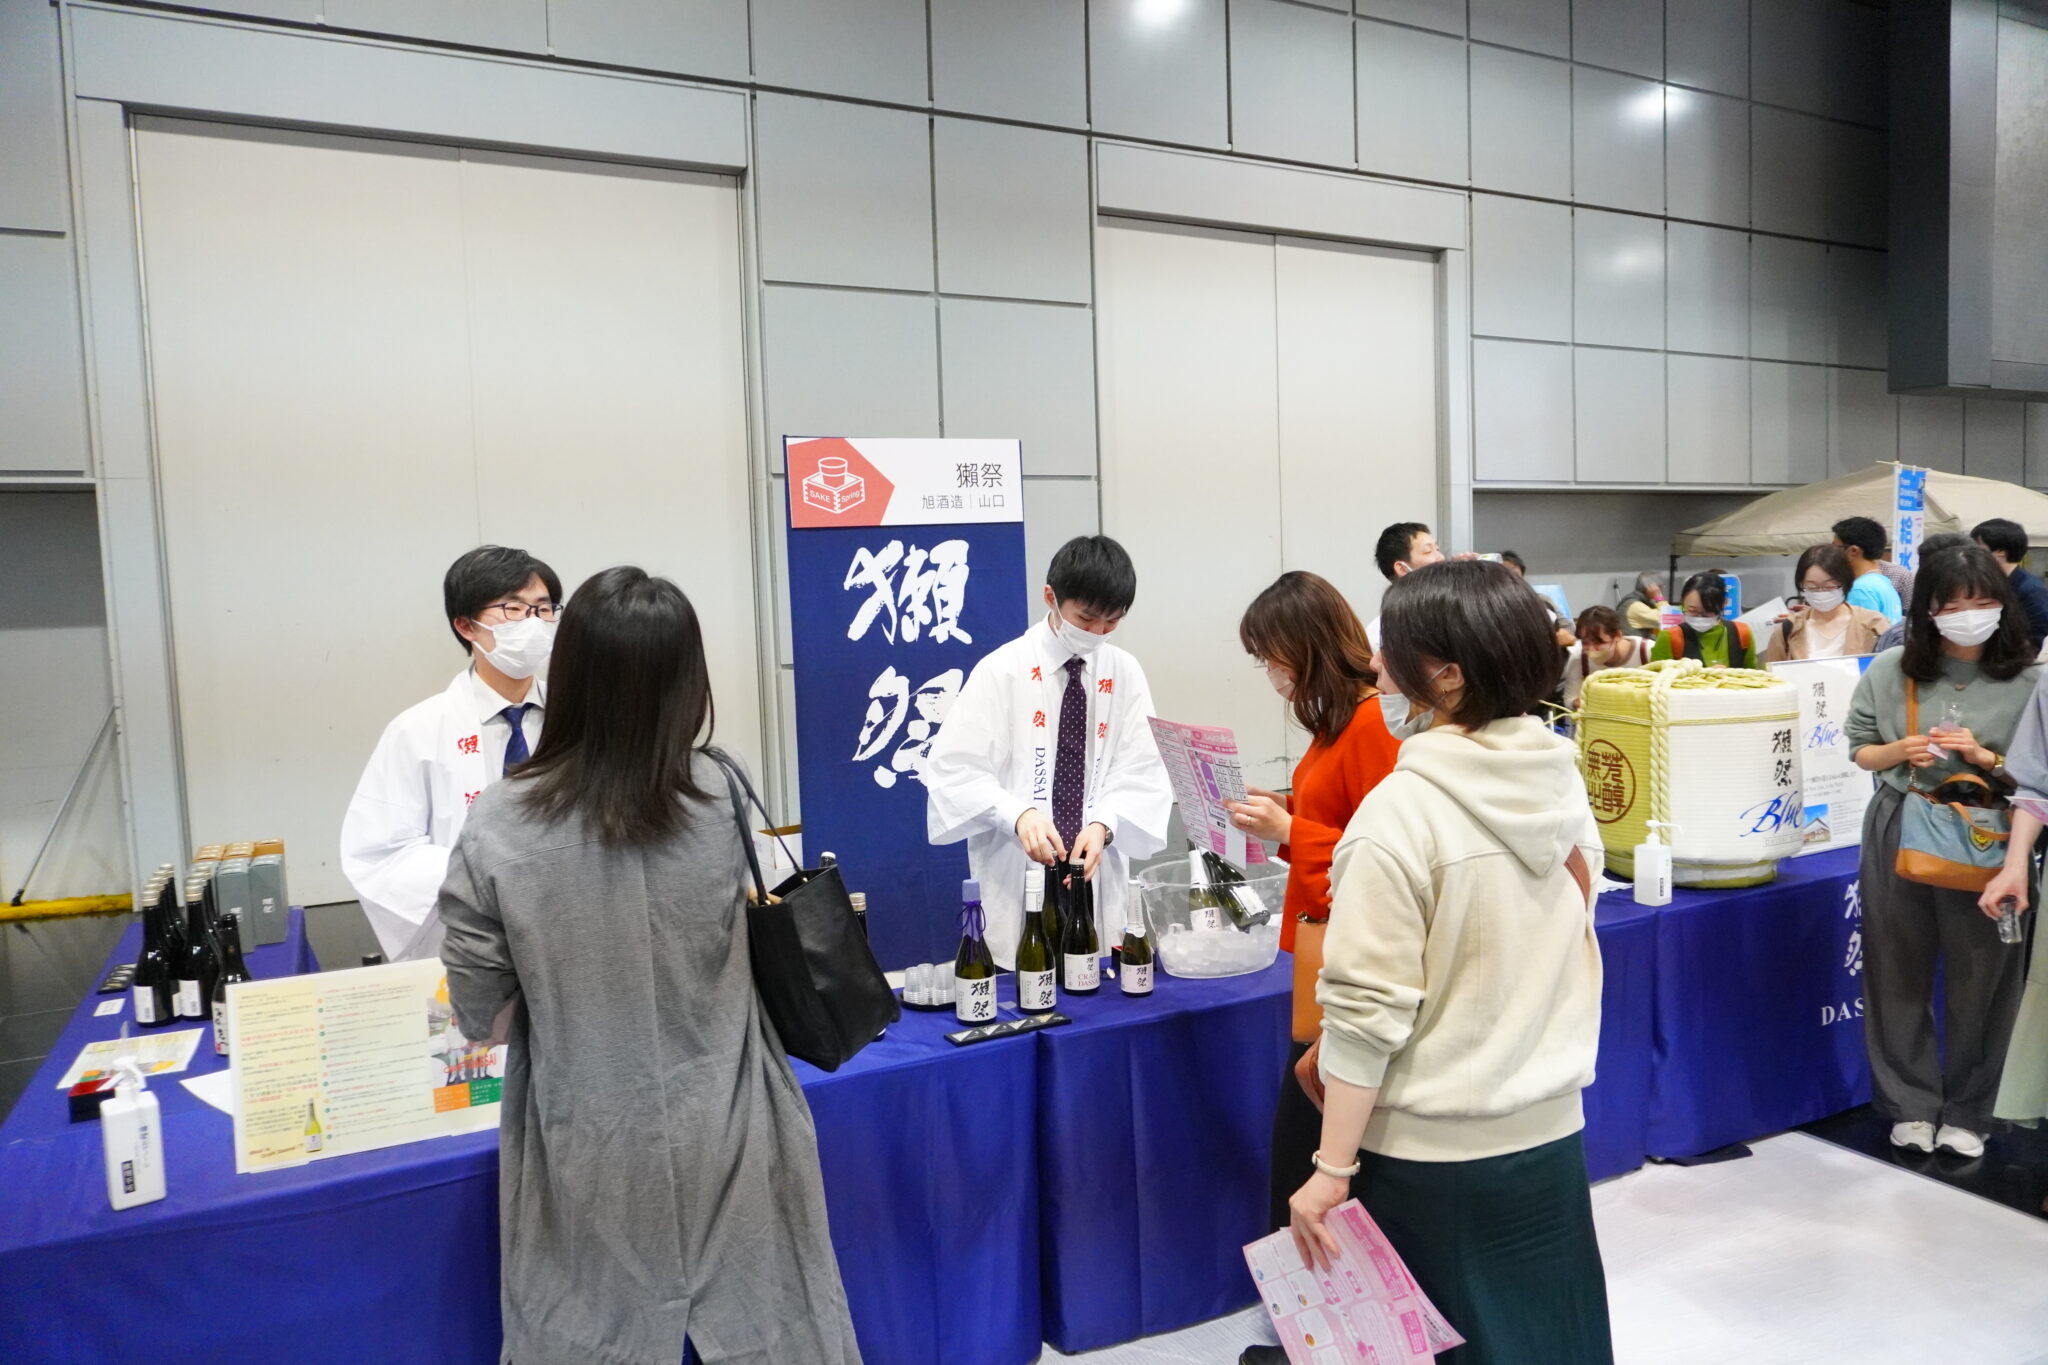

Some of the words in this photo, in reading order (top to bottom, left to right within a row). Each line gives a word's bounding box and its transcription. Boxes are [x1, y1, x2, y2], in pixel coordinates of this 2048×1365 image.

[956, 462, 1003, 488] 獺祭
[809, 489, 831, 503] SAKE
[841, 489, 860, 504] Spring
[922, 494, 963, 510] 旭酒造
[979, 494, 1005, 509] 山口
[1804, 721, 1845, 751] Blue
[1033, 747, 1047, 801] DASSAI
[1772, 728, 1793, 787] 獺祭
[1739, 790, 1800, 838] Blue
[971, 980, 990, 1018] 獺祭
[1038, 972, 1053, 1006] 獺祭
